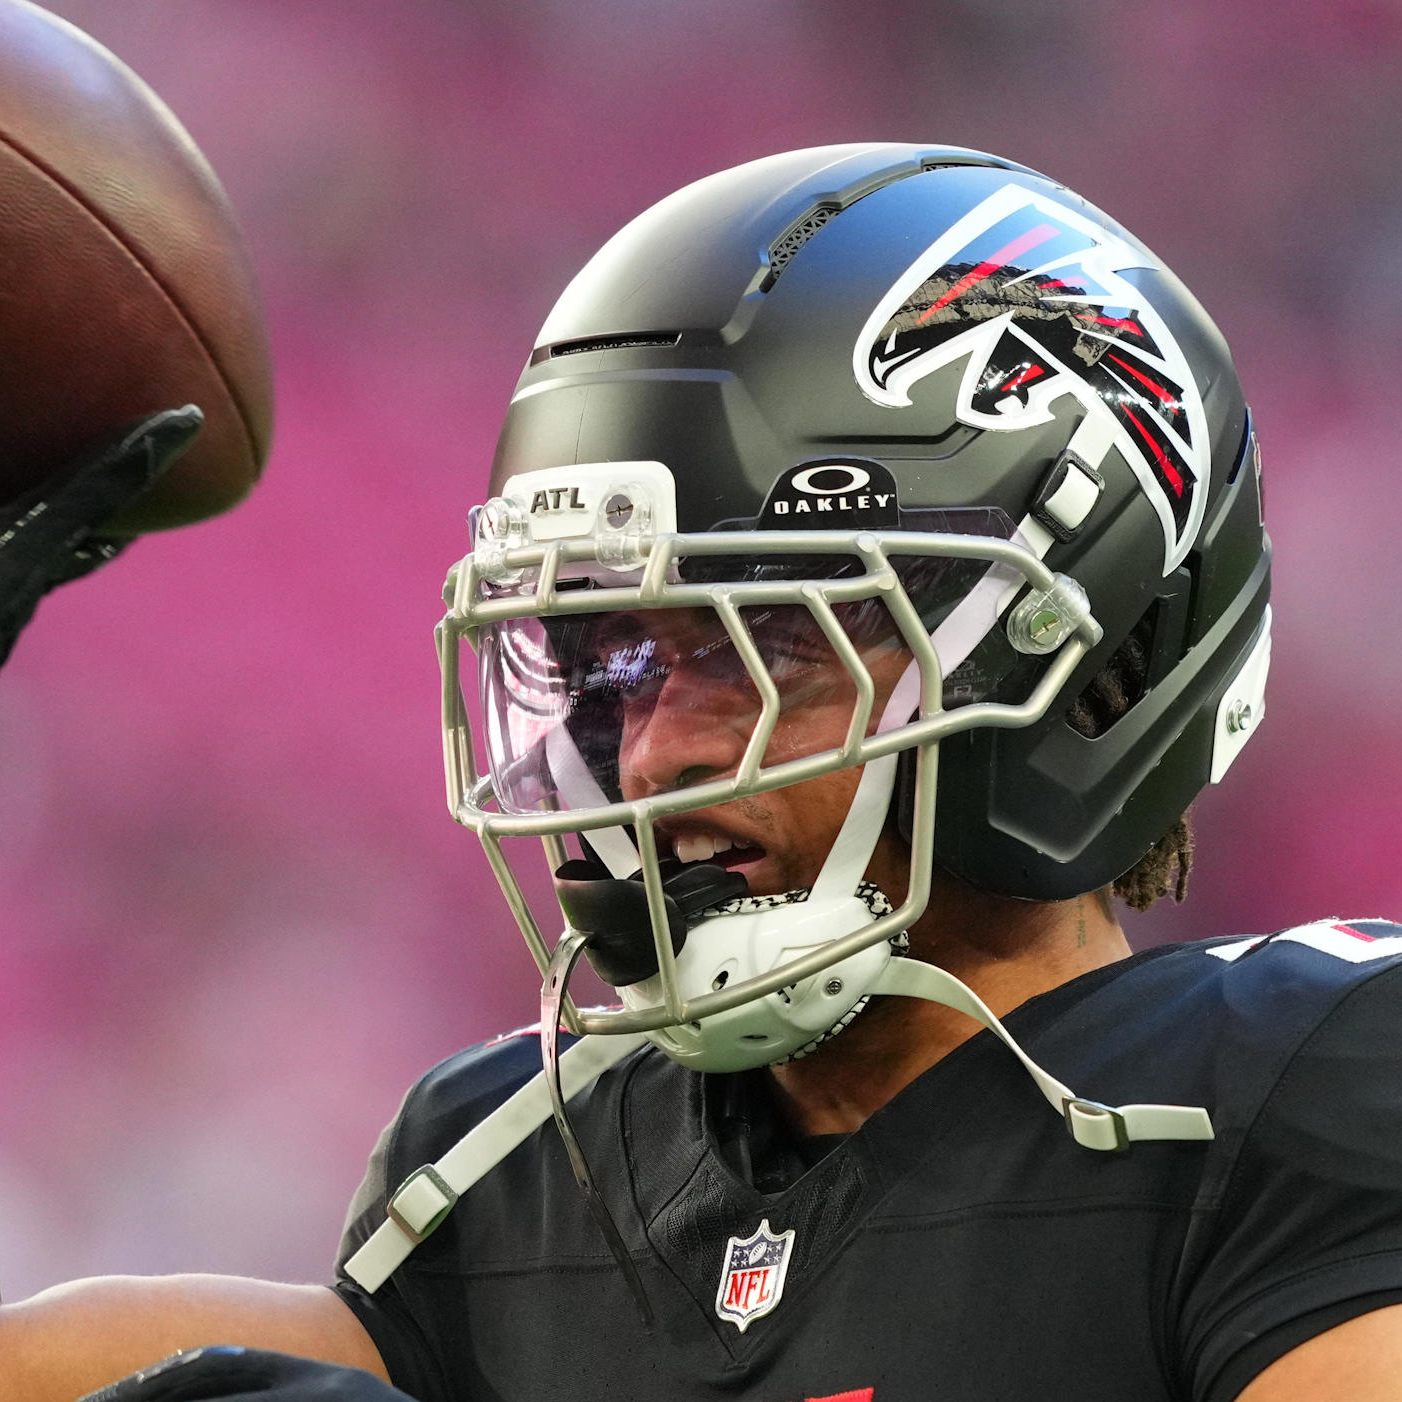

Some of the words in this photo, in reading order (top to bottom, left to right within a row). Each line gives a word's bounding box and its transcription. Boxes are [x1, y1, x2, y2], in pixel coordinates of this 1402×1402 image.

[529, 487, 586, 514] ATL
[773, 494, 890, 515] OAKLEY
[725, 1268, 770, 1310] NFL
